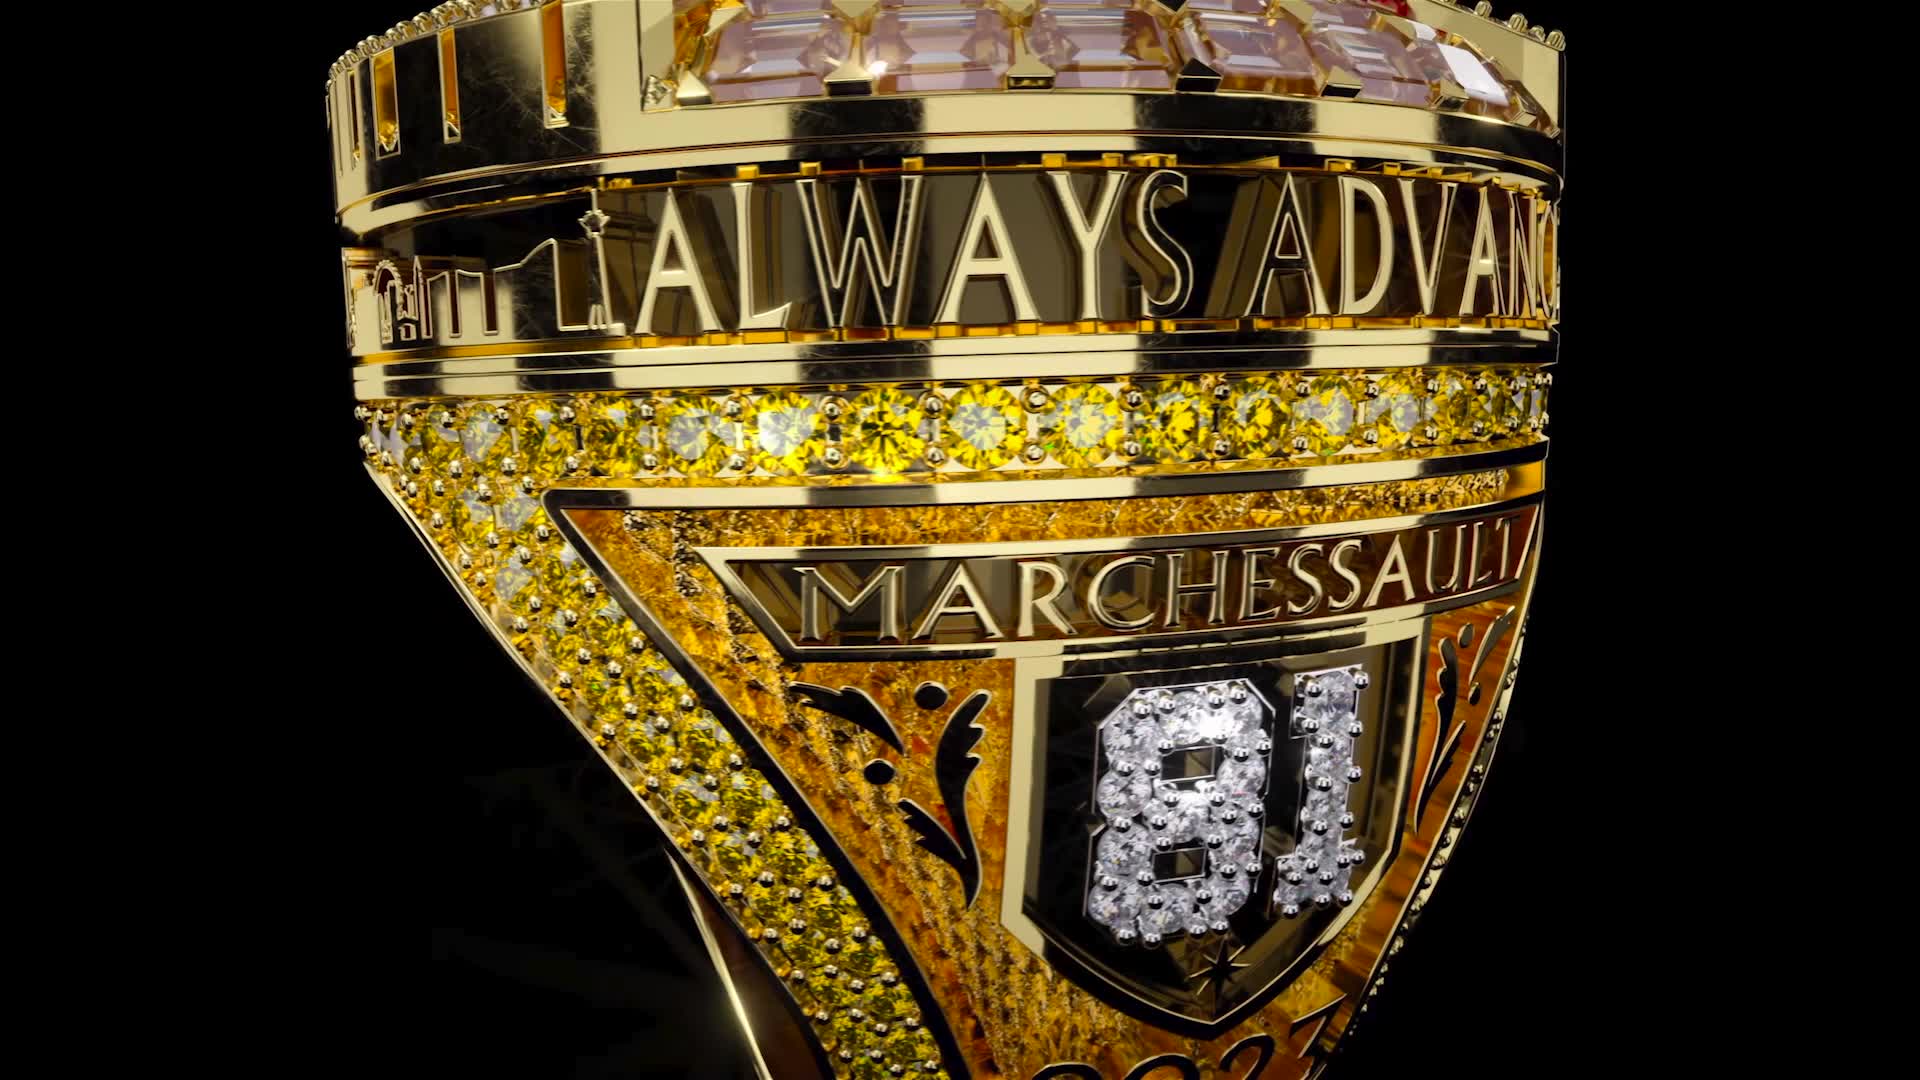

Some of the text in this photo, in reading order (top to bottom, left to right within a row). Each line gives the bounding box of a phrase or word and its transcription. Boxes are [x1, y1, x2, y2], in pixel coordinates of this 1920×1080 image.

[633, 170, 1194, 335] ALWAYS
[793, 516, 1521, 643] MARCHESSAULT
[1083, 663, 1371, 948] 81
